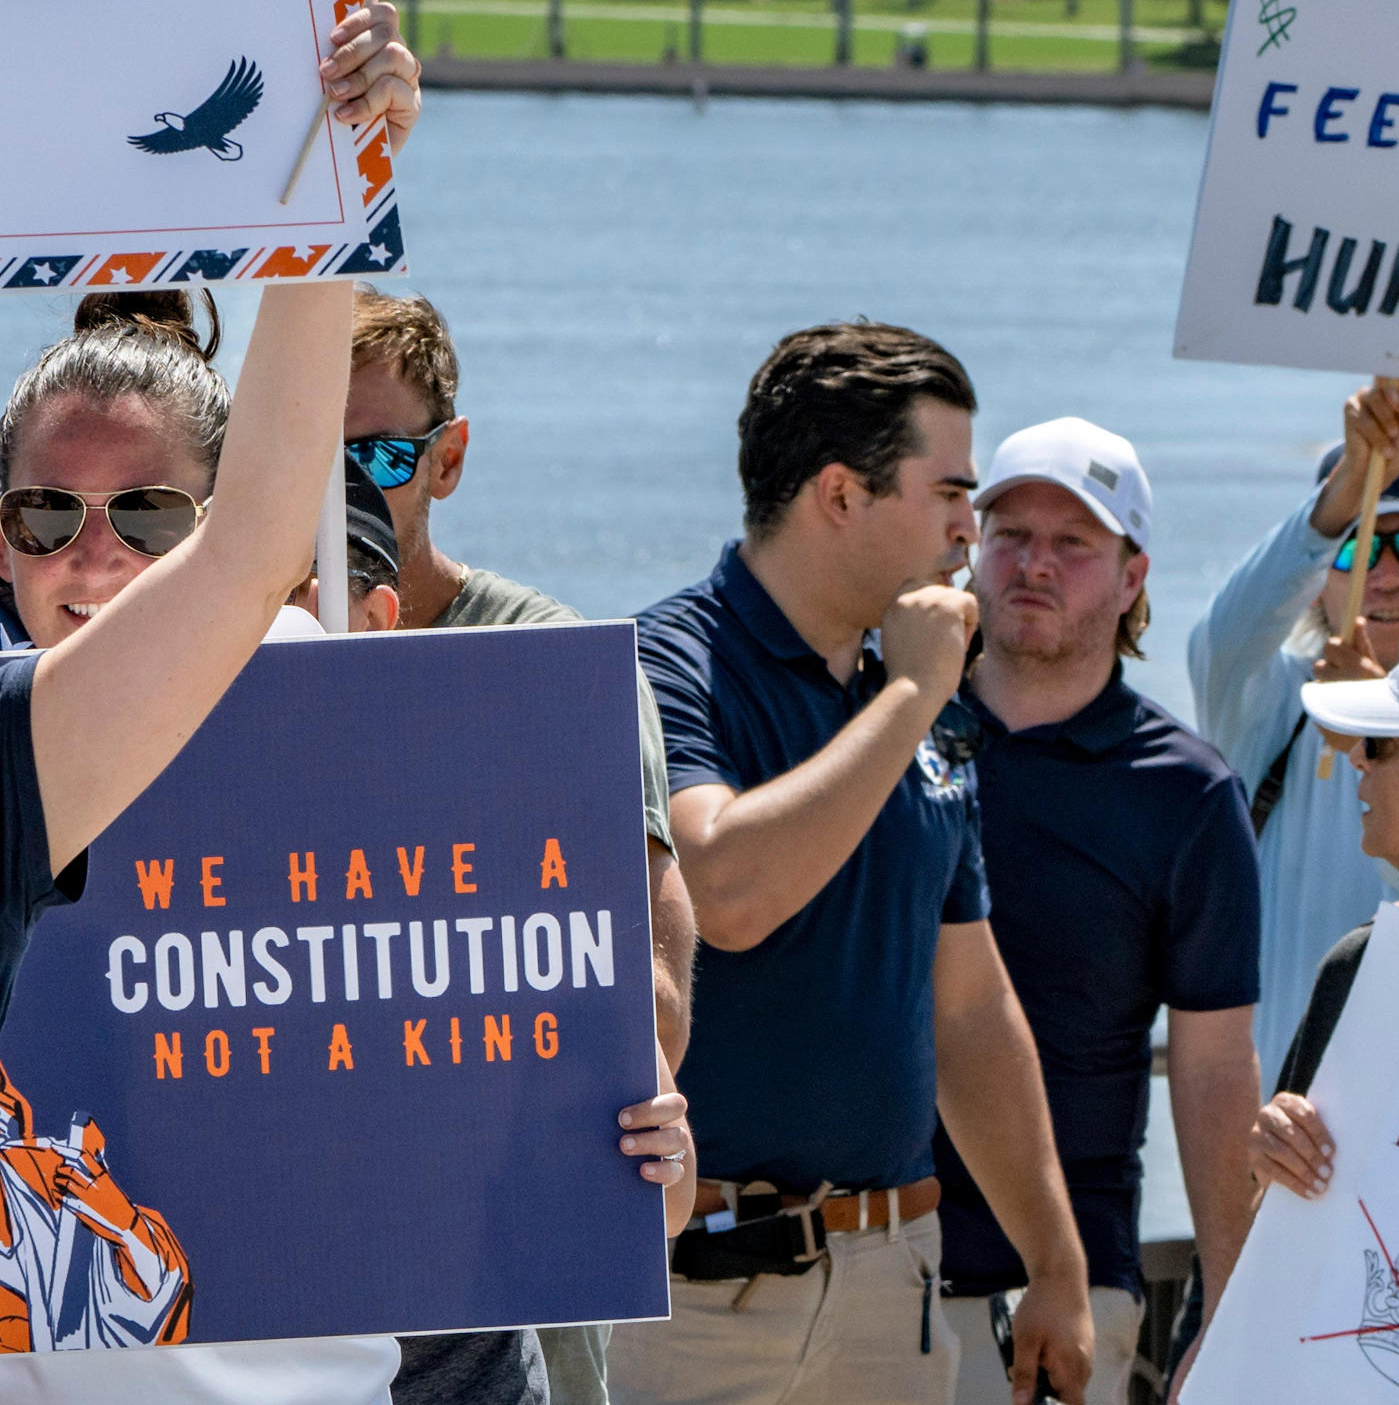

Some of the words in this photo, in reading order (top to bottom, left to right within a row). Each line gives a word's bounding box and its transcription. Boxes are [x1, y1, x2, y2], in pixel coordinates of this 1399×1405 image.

[135, 855, 227, 910] WE
[287, 842, 479, 903] HAVE
[540, 838, 568, 889] A
[105, 910, 616, 1014] CONSTITUTION
[153, 1027, 276, 1079] NOT
[328, 1024, 354, 1071] A
[403, 1011, 560, 1067] KING
